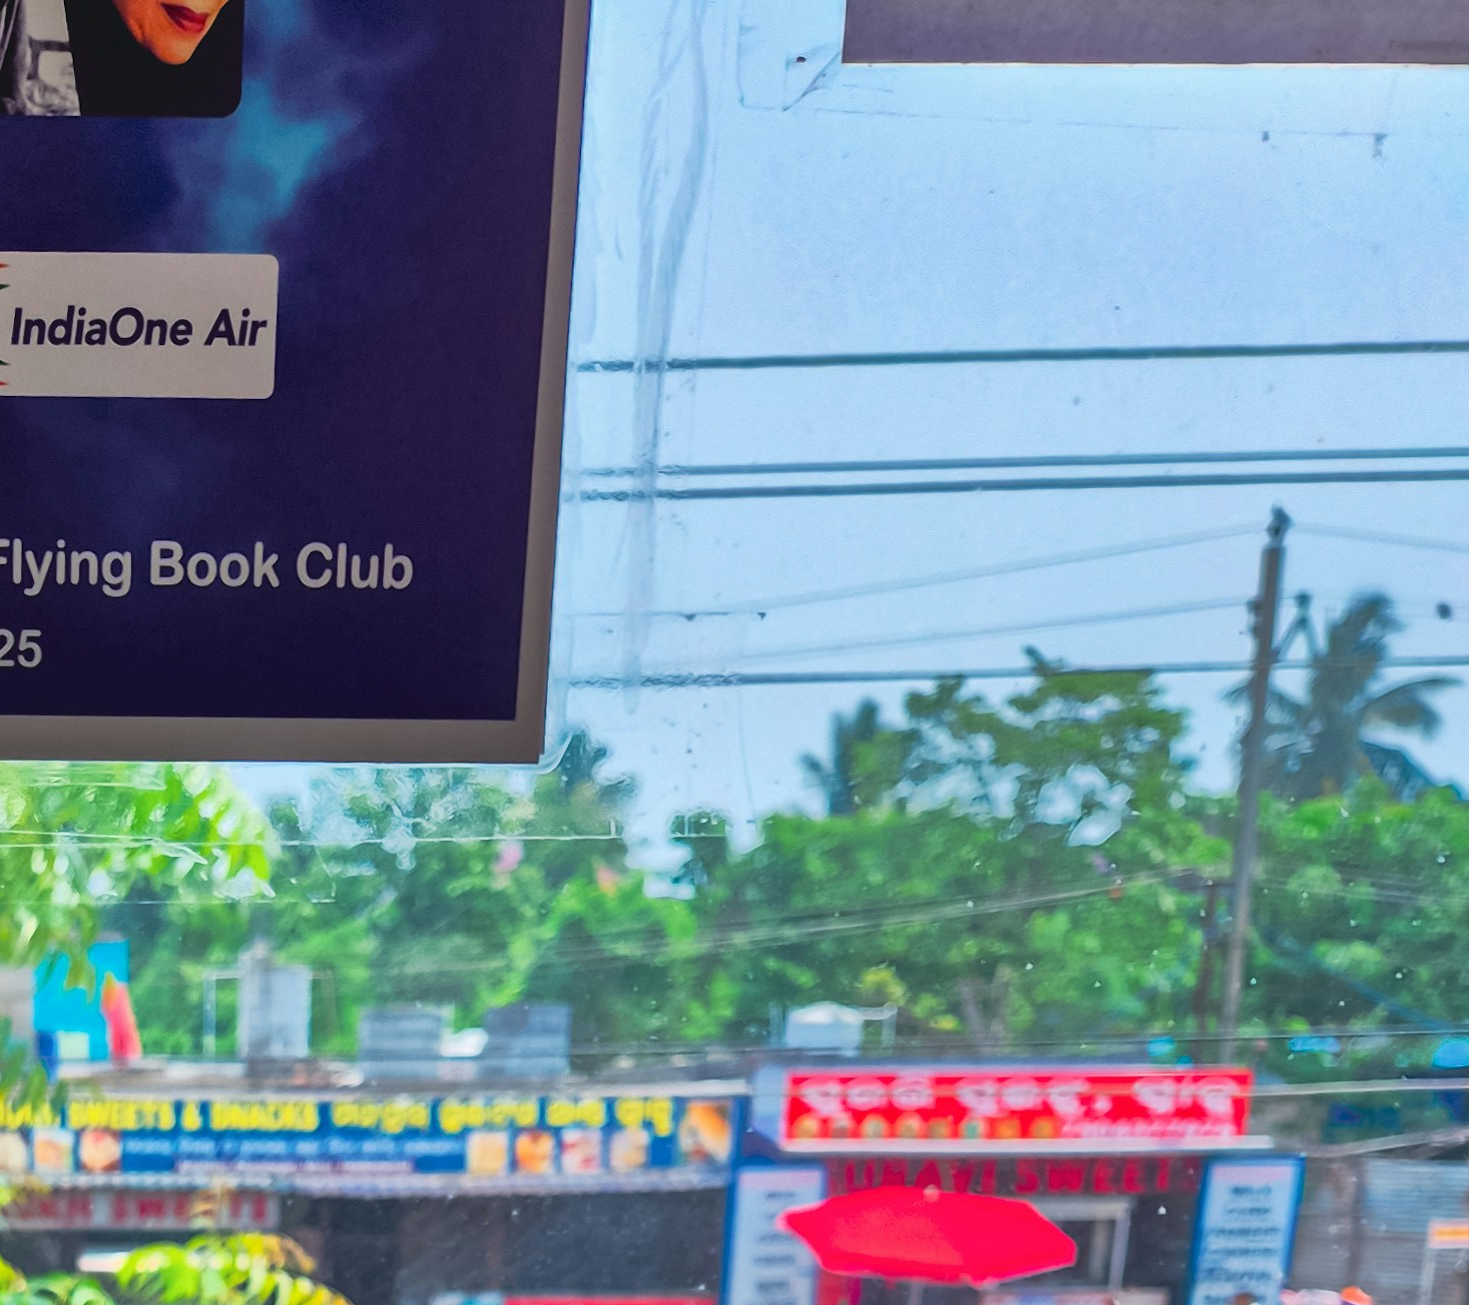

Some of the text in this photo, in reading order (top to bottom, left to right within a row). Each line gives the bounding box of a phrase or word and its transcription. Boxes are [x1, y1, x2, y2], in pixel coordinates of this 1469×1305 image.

[12, 305, 267, 346] IndiaOne Air
[151, 540, 279, 587] Book
[297, 542, 413, 589] Club
